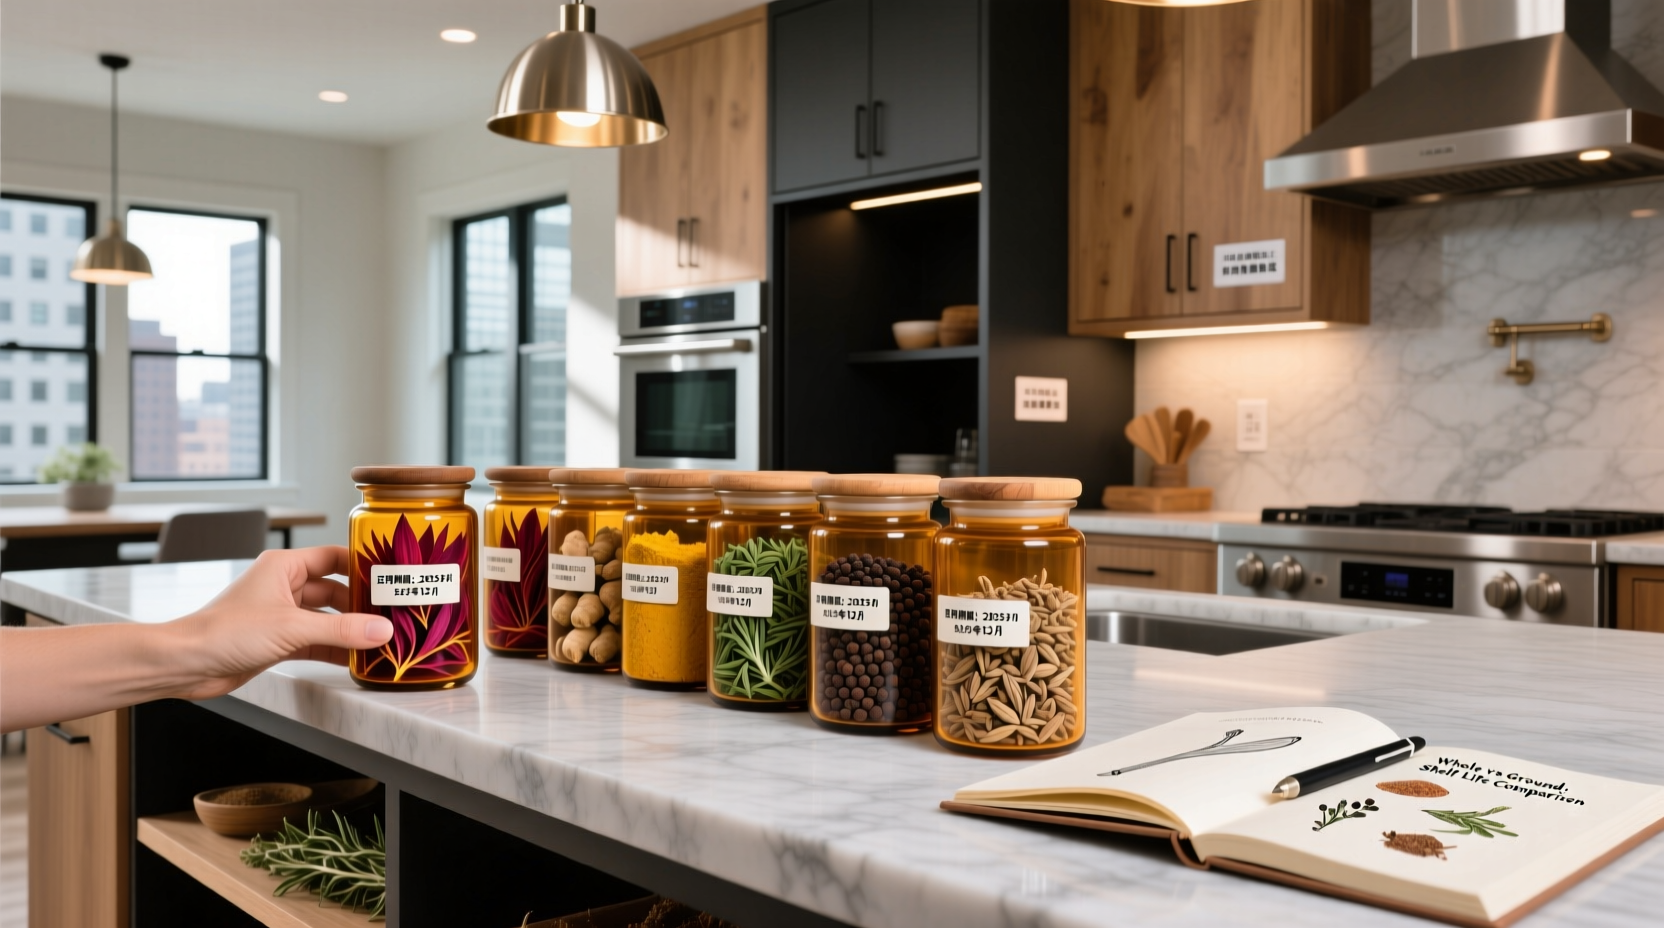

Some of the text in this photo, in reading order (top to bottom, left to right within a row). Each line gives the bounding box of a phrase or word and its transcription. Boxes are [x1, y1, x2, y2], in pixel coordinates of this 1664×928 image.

[1438, 756, 1482, 772] Whole
[1418, 764, 1460, 777] Shelf
[1461, 771, 1490, 784] Life
